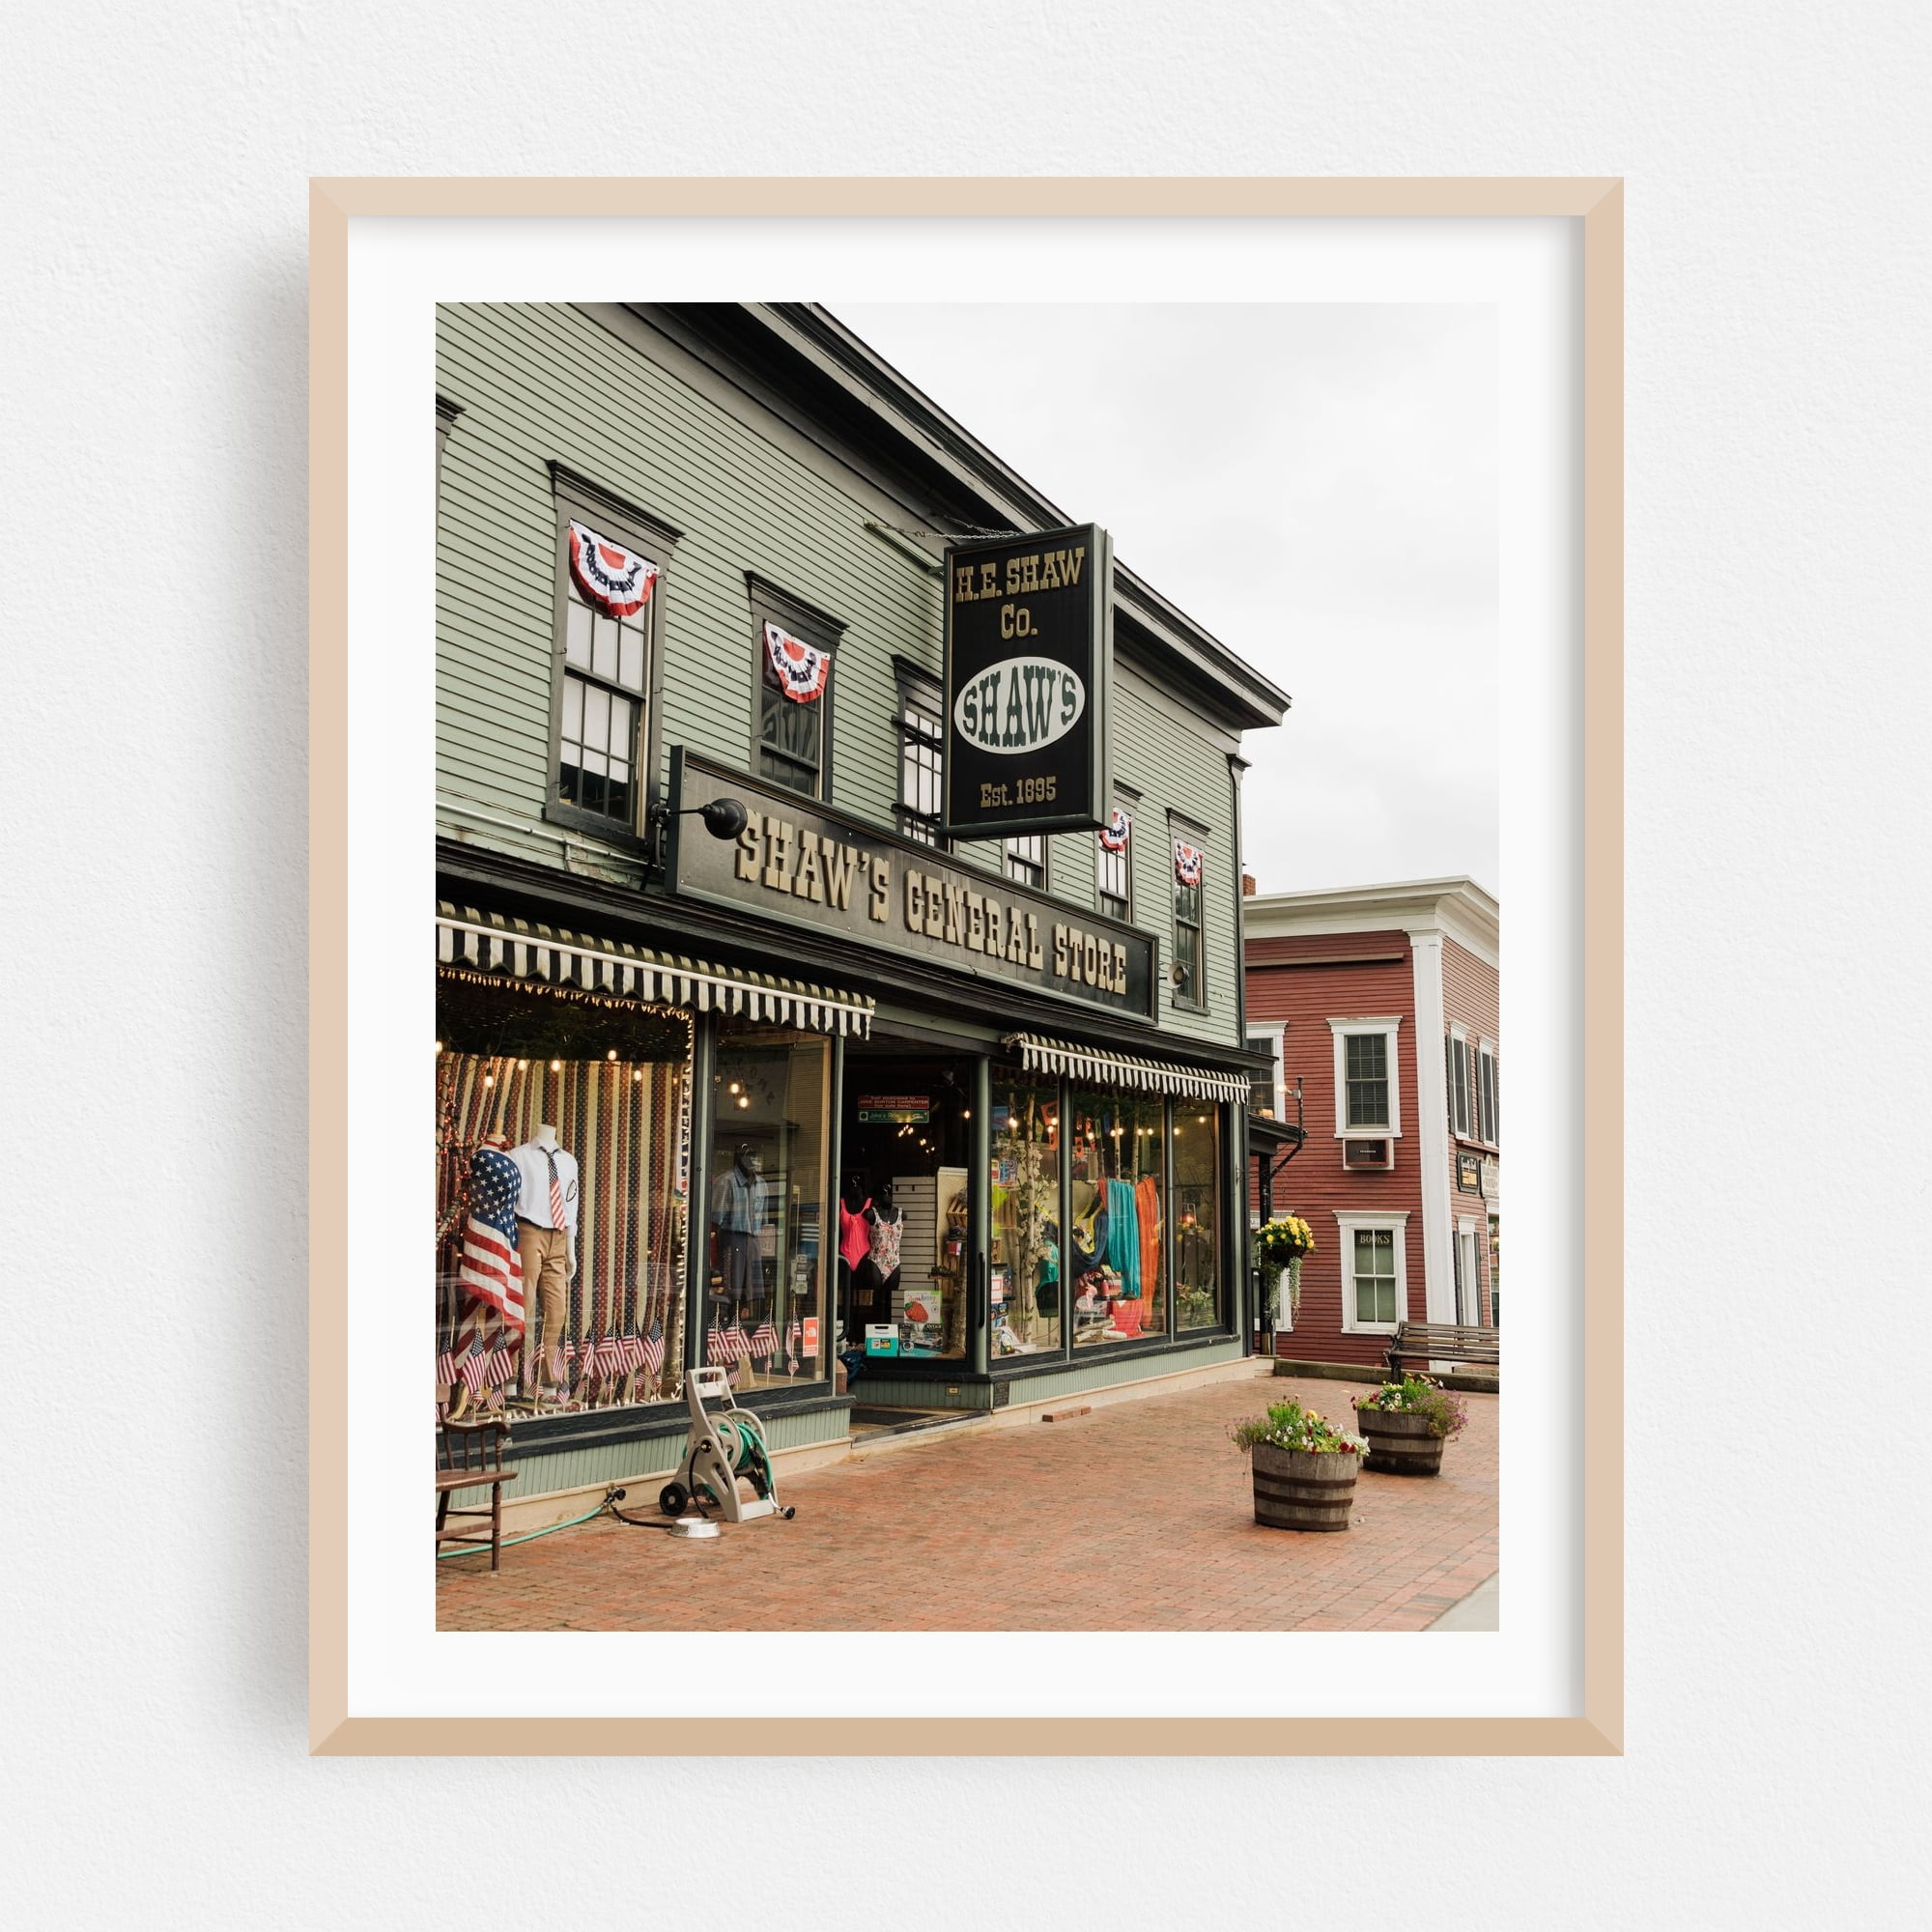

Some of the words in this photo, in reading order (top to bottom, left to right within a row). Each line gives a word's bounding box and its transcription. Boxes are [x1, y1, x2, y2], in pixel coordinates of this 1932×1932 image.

[955, 562, 1002, 603] H.E.
[1007, 547, 1085, 595] SHAW
[962, 665, 1077, 748] SHAW'S
[980, 782, 1013, 808] Est.
[1016, 776, 1057, 804] 1895
[734, 809, 890, 923] SHAW'S
[905, 869, 1043, 971] GENERAL
[1053, 921, 1127, 995] STORE
[1360, 1234, 1390, 1244] BOOKS
